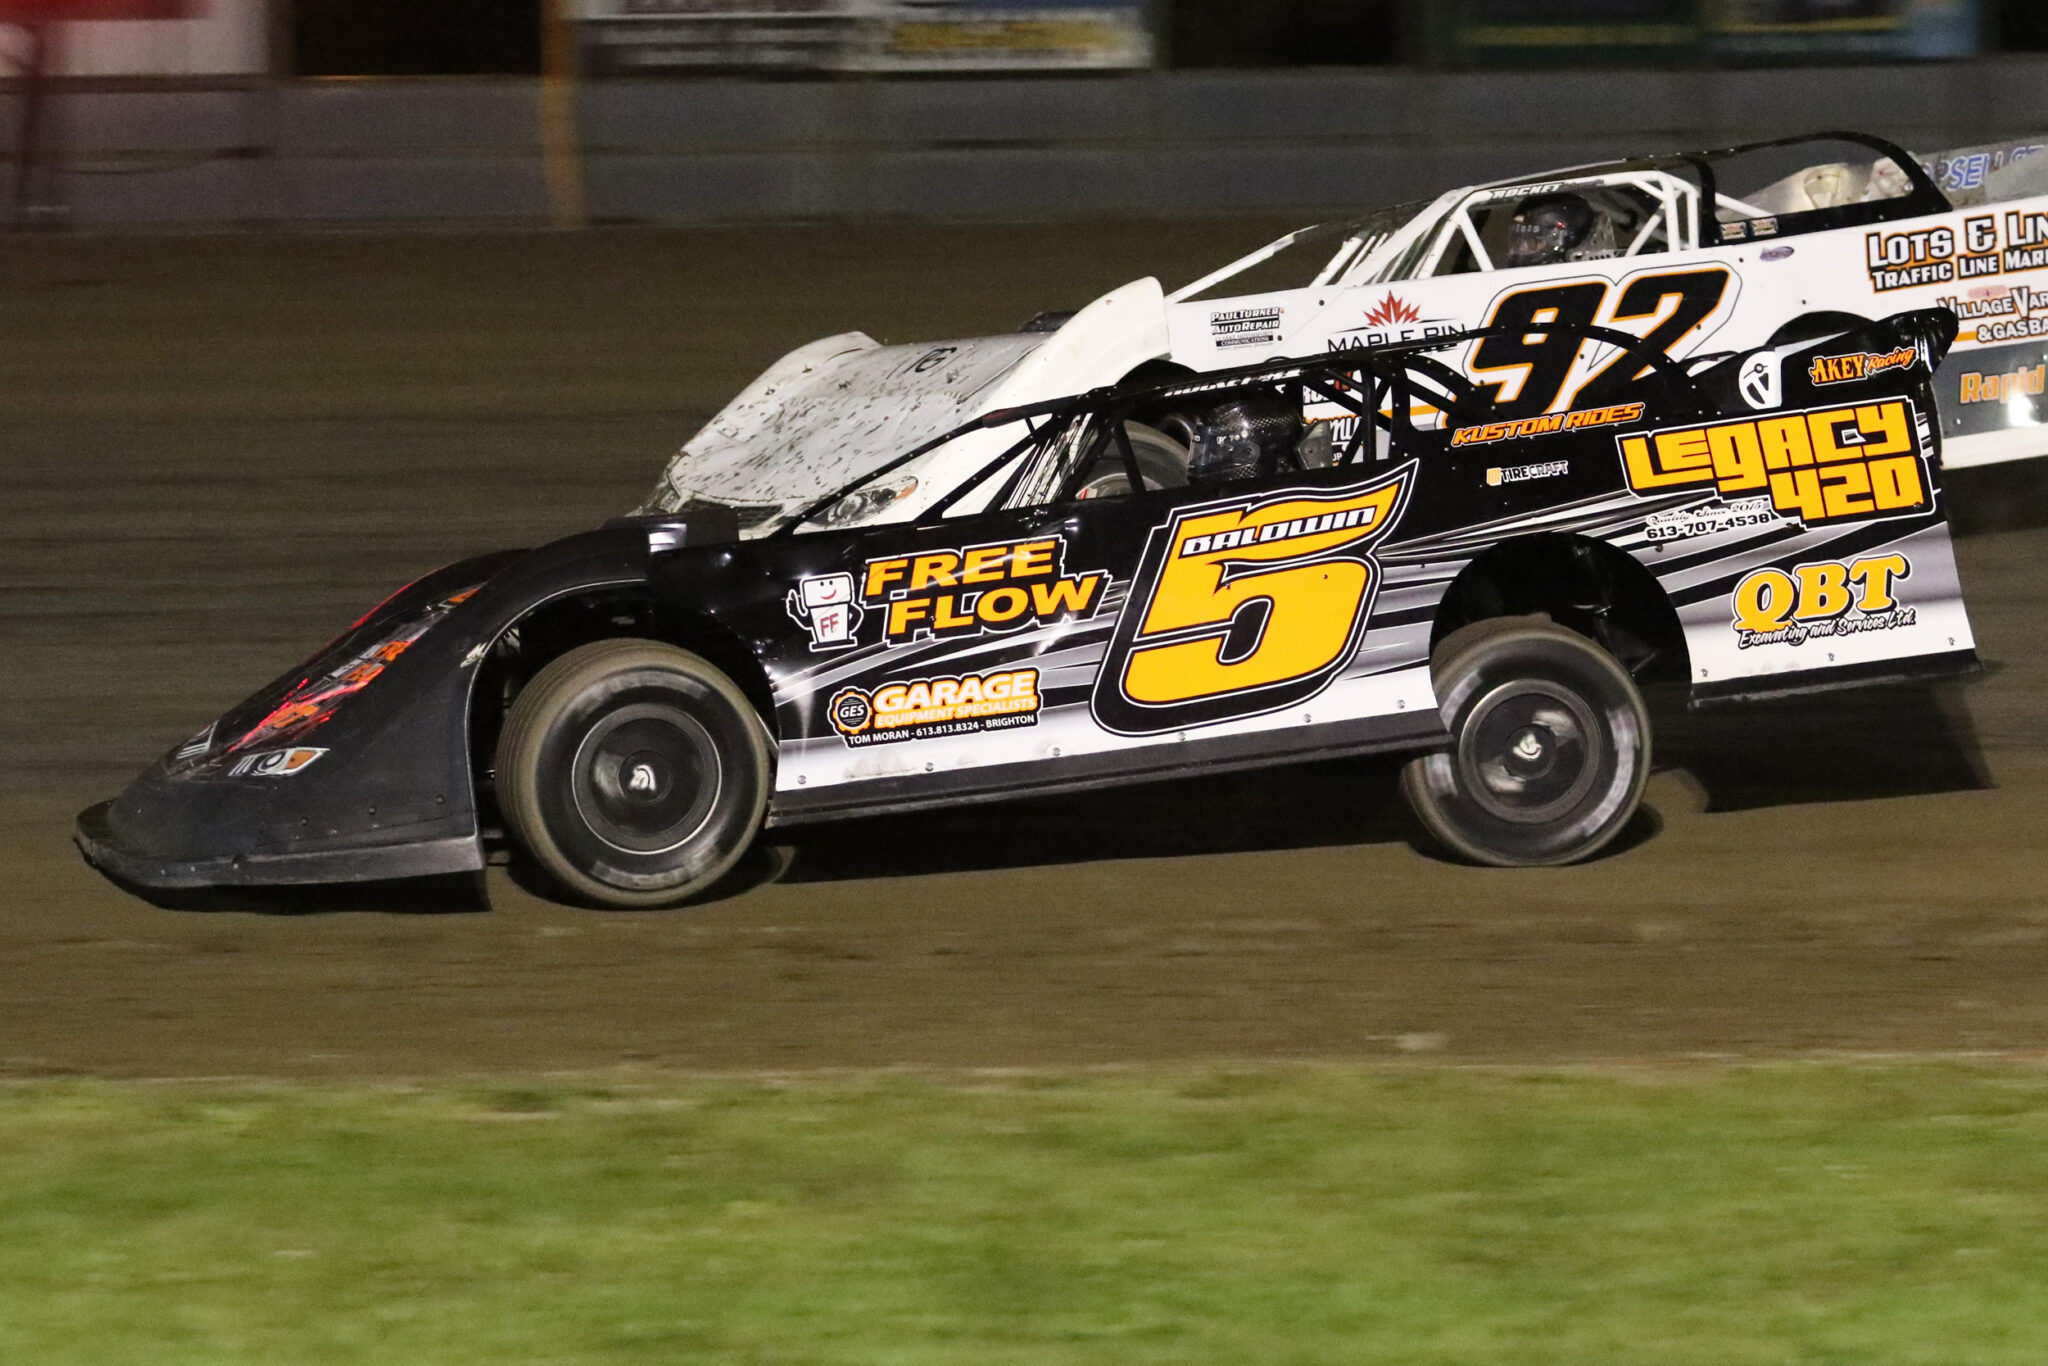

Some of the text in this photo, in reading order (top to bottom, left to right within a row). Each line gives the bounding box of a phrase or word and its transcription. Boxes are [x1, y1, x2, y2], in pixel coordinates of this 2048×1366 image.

[1867, 228, 1954, 269] LOTS
[1966, 216, 1996, 252] &
[1872, 249, 2048, 291] TRAFFIC LINE MAR
[1468, 267, 1730, 415] 92
[1812, 348, 1915, 384] AKEY Racing
[1961, 364, 2046, 404] Rapid
[1453, 403, 1645, 445] KUSTOM RIDES
[1501, 460, 1569, 482] TIRECRAFT
[1769, 455, 1924, 521] 420
[1647, 513, 1770, 538] 613-707-4538
[1732, 501, 1762, 513] 2015
[1181, 506, 1377, 557] BALDWIN
[865, 540, 1055, 597] FREE
[889, 576, 1099, 635] FLOW
[1119, 474, 1405, 708] 5
[1734, 554, 1908, 632] QBT
[820, 613, 839, 637] FF
[1738, 625, 1808, 649] Excavating
[1809, 620, 1836, 639] and
[1836, 615, 1888, 636] Services
[840, 704, 865, 718] GES
[873, 670, 1037, 713] GARAGE
[874, 695, 1038, 729] EQUIPMENT SPECIALISTS
[849, 734, 871, 745] TOM
[873, 730, 909, 743] MORAN
[916, 721, 979, 737] 613.813.8324
[986, 714, 1035, 729] BRIGHTON
